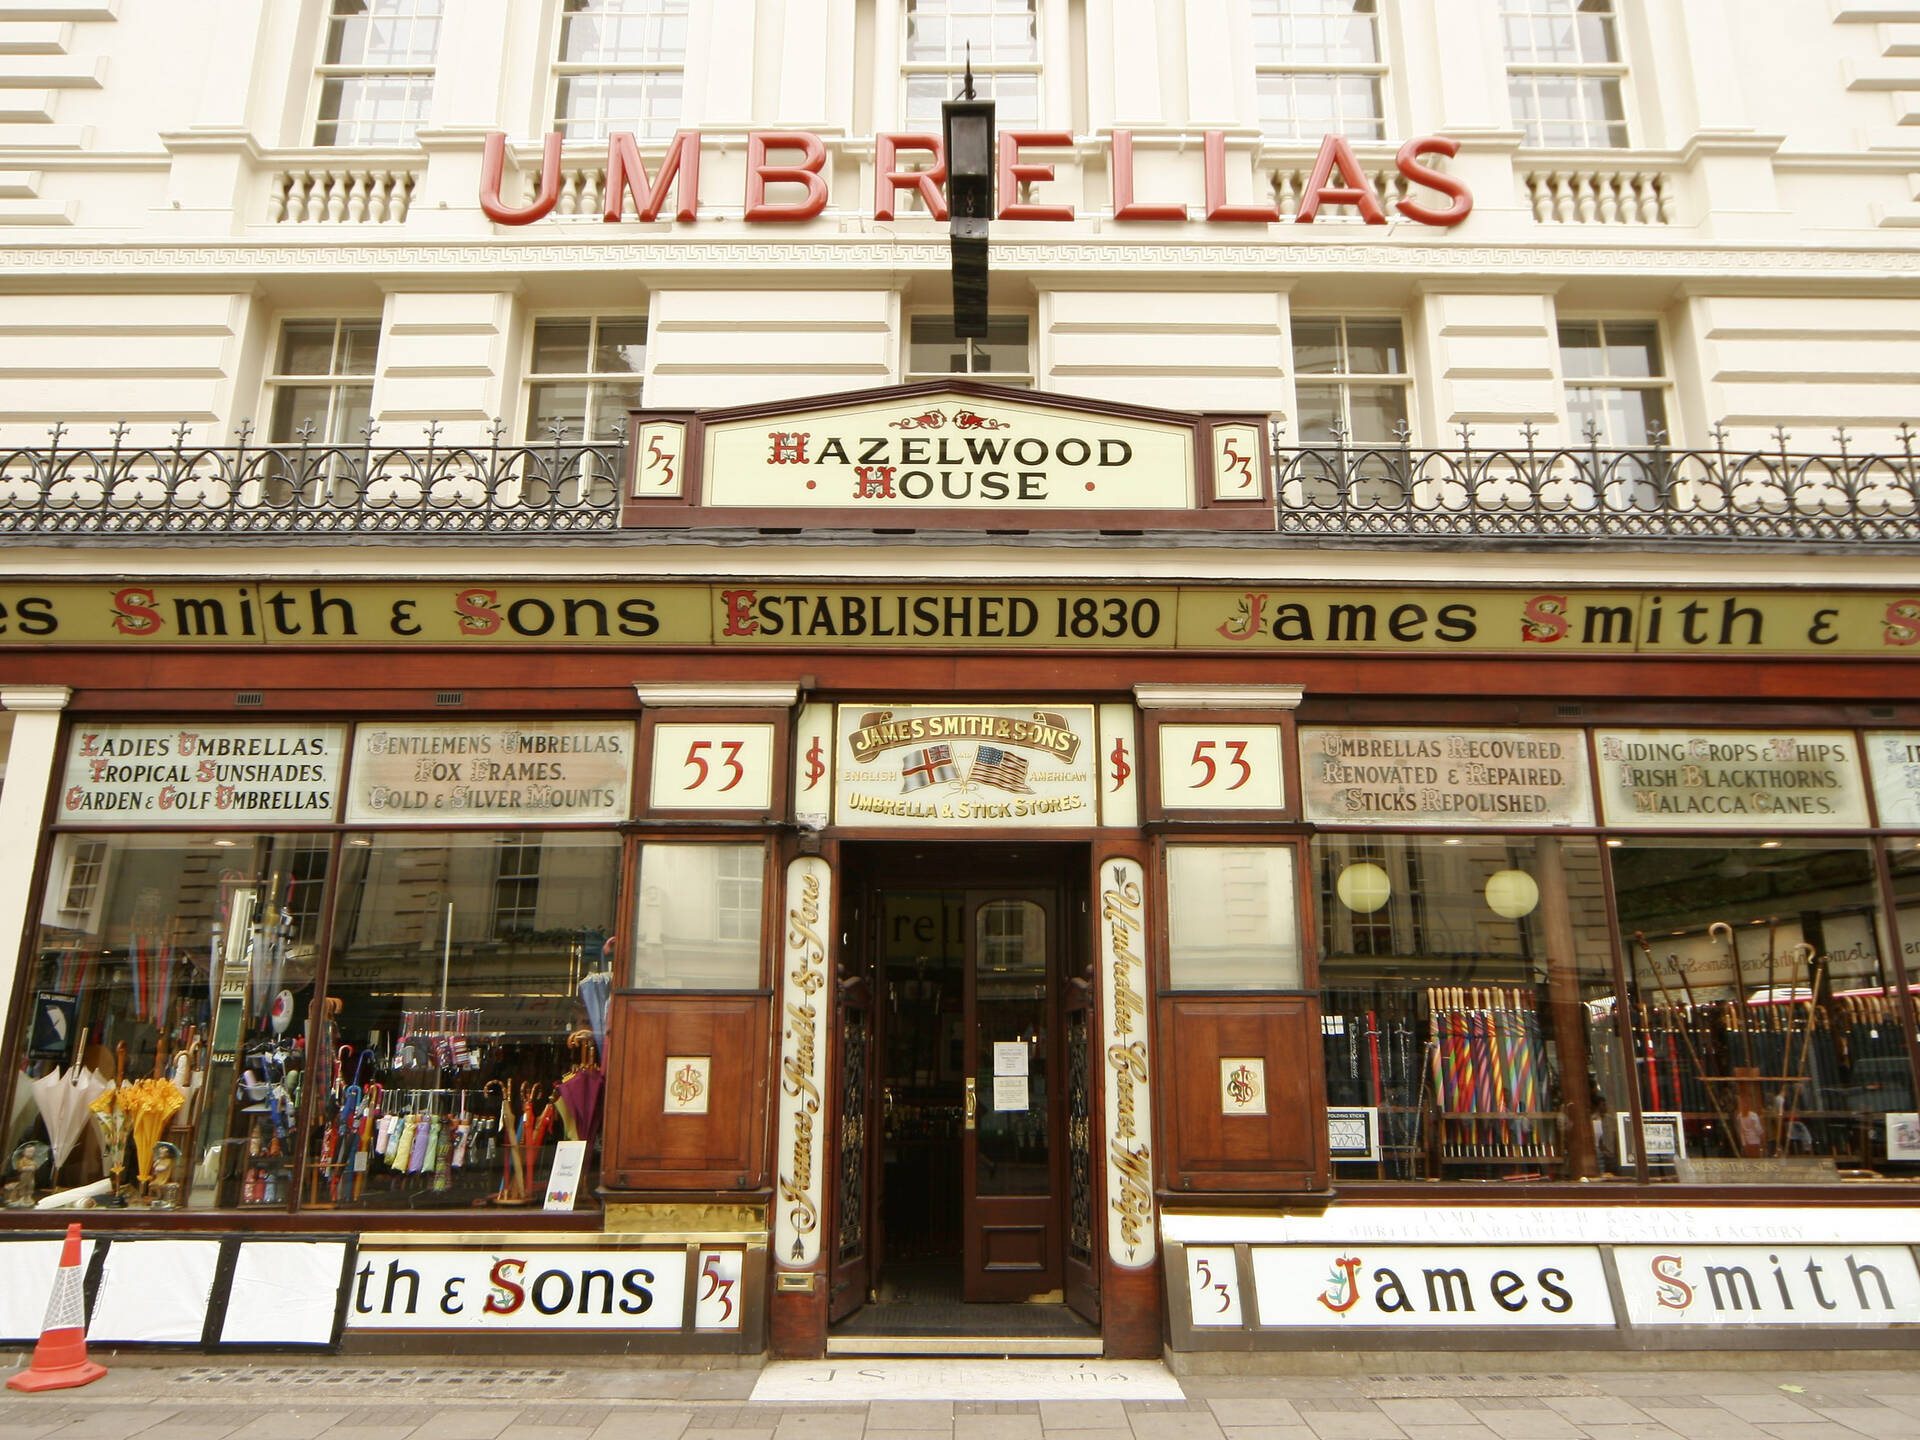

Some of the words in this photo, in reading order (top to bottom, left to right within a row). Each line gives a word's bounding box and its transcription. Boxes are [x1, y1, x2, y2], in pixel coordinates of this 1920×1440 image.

[478, 129, 1472, 228] UMBRELLAS
[767, 431, 1132, 466] HAZELWOOD
[853, 466, 1049, 500] HOUSE
[113, 587, 357, 636] Smith
[456, 588, 660, 636] Sons
[721, 588, 1039, 638] ESTABLISHED
[1056, 597, 1161, 639] 1830
[1216, 593, 1477, 643] James
[1522, 595, 1763, 645] Smith
[178, 732, 328, 757] UMBRELLAS.
[856, 719, 925, 751] JAMES
[929, 716, 993, 737] SMITH
[996, 719, 1011, 738] &
[1321, 734, 1442, 758] UMBRELLAS
[1602, 736, 1685, 762] RIDING
[1688, 738, 1758, 762] CROPS
[88, 758, 192, 783] TROPICAL
[196, 759, 326, 783] SUNSHADES.
[415, 758, 461, 783] FOX
[471, 758, 566, 783] FRAMES.
[683, 740, 744, 792] 53
[843, 771, 898, 782] ENGLISH
[1029, 771, 1087, 782] AMERICAN
[1188, 740, 1251, 790] 53
[1322, 760, 1438, 785] RENOVATED
[1467, 762, 1566, 787] REPAIRED.
[1618, 764, 1677, 788] IRISH
[1682, 764, 1842, 789] BLACKTHORNS.
[66, 785, 142, 811] GARDEN
[158, 785, 212, 811] GOLF
[215, 784, 332, 811] UMBRELLAS.
[369, 785, 428, 810] GOLD
[450, 785, 521, 810] SILVER
[527, 784, 614, 808] MOUNTS
[848, 792, 937, 818] UMBRELLA
[941, 803, 954, 819] &
[957, 800, 1012, 819] STICK
[1346, 788, 1417, 812] STICKS
[1422, 788, 1551, 814] REPOLISHED.
[1633, 790, 1748, 814] MALACCA
[1750, 791, 1836, 814] CANES.
[355, 1259, 420, 1314] th
[483, 1256, 655, 1316] Sons
[1316, 1255, 1573, 1314] James
[1651, 1254, 1896, 1313] Smith
